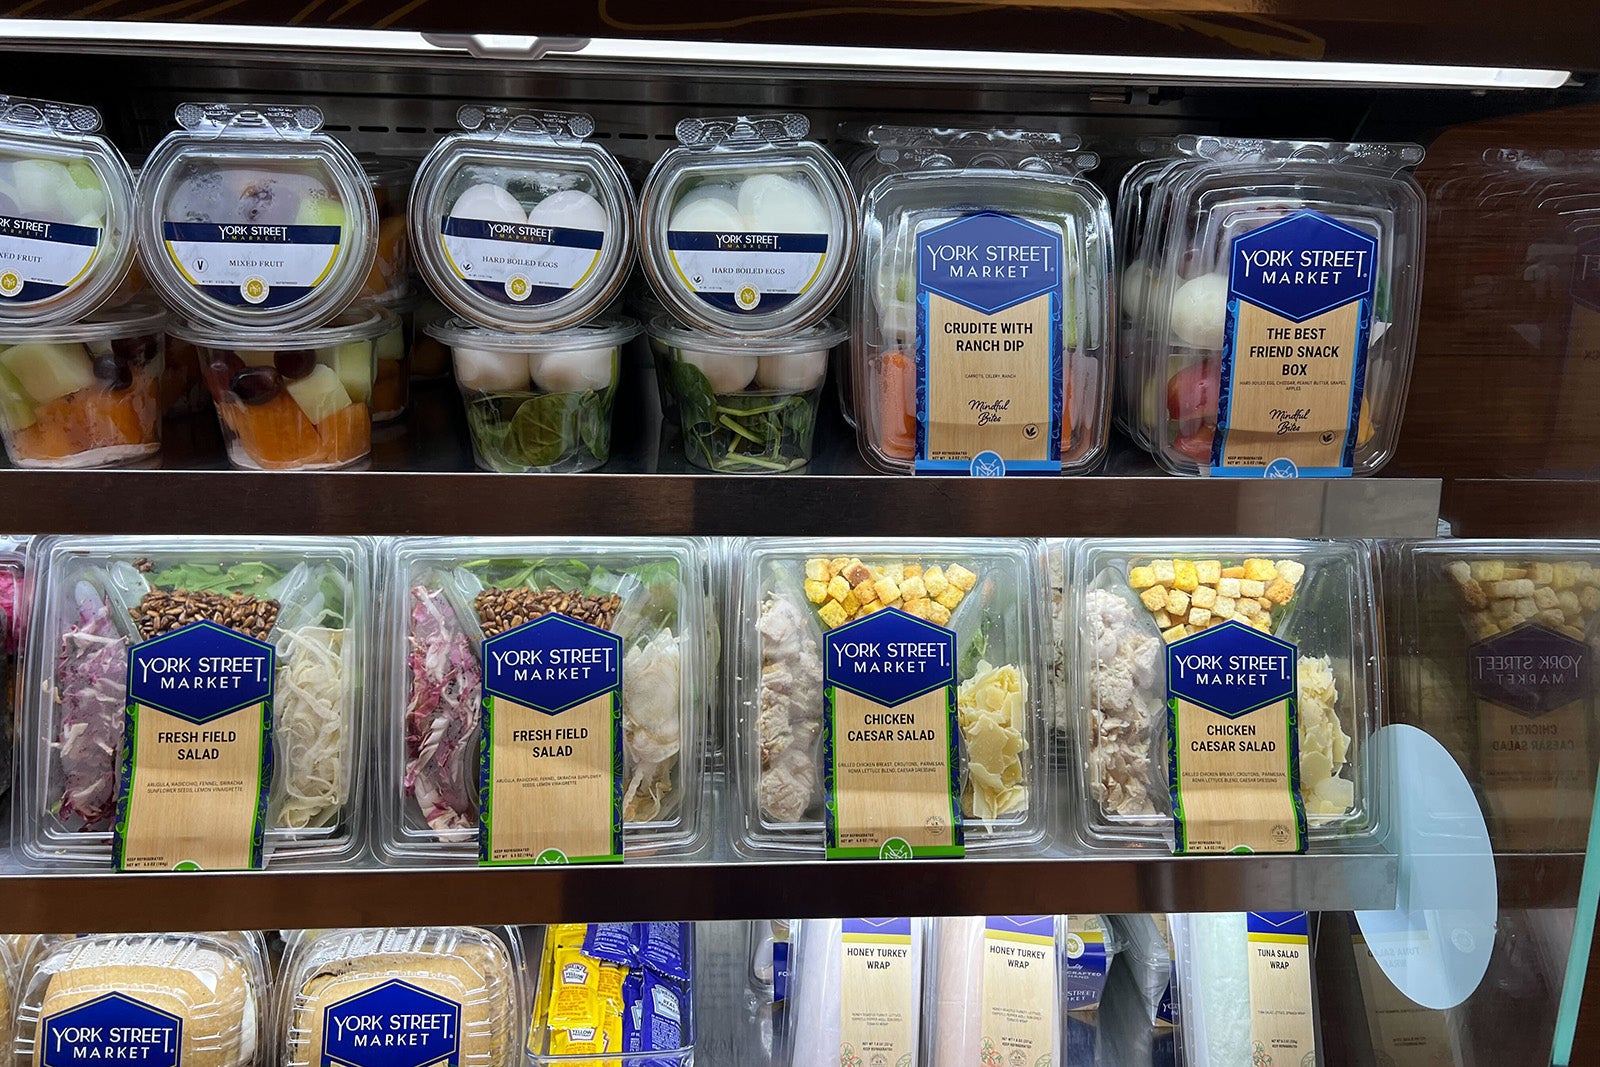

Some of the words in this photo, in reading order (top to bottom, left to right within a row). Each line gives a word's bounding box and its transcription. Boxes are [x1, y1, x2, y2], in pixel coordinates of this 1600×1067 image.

[14, 220, 50, 238] STREET
[218, 225, 248, 240] YORK
[251, 226, 288, 241] STREET
[488, 223, 516, 237] YORK
[518, 226, 553, 242] STREET
[500, 234, 542, 242] MARKET
[716, 234, 742, 248] YORK
[745, 235, 779, 250] STREET
[17, 253, 42, 262] FRUIT
[506, 258, 536, 266] BOILED
[926, 244, 979, 271] YORK
[986, 246, 1052, 272] STREET
[1241, 250, 1294, 277] YORK
[1300, 250, 1367, 278] STREET
[950, 266, 1029, 278] MARKET
[1262, 272, 1342, 284] MARKET
[944, 322, 997, 334] CRUDITE
[1001, 323, 1033, 334] WITH
[1267, 328, 1291, 340] THE
[1294, 328, 1326, 340] BEST
[956, 340, 999, 351] RANCH
[1004, 340, 1024, 351] DIP
[1250, 346, 1293, 358] FRIEND
[1297, 346, 1340, 358] SNACK
[1282, 364, 1308, 376] BOX
[968, 400, 1010, 412] Mindful
[978, 412, 1001, 426] Bites
[1269, 409, 1310, 421] Mindful
[1277, 421, 1300, 435] Bites
[833, 643, 881, 667] YORK
[888, 643, 947, 666] STREET
[492, 650, 543, 676] YORK
[550, 648, 613, 672] STREET
[854, 661, 927, 673] MARKET
[1175, 655, 1222, 678] YORK
[1229, 656, 1288, 680] STREET
[138, 657, 191, 683] YORK
[199, 657, 265, 682] STREET
[515, 667, 591, 681] MARKET
[161, 676, 241, 689] MARKET
[1197, 674, 1267, 685] MARKET
[864, 714, 915, 725] CHICKEN
[513, 730, 552, 742] FRESH
[555, 728, 588, 740] FIELD
[848, 731, 894, 741] CAESAR
[897, 730, 935, 741] SALAD
[1206, 725, 1256, 736] CHICKEN
[158, 732, 198, 743] FRESH
[202, 731, 236, 743] FIELD
[532, 746, 573, 758] SALAD
[1191, 741, 1236, 751] CAESAR
[1239, 741, 1276, 751] SALAD
[178, 749, 219, 760] SALAD
[847, 948, 875, 957] HONEY
[877, 949, 907, 958] TURKEY
[990, 945, 1015, 956] HONEY
[1017, 949, 1046, 959] TURKEY
[1258, 949, 1275, 957] TUNA
[1277, 949, 1299, 959] SALAD
[867, 961, 891, 969] WRAP
[1008, 959, 1030, 969] WRAP
[1270, 961, 1289, 969] WRAP
[333, 1015, 383, 1041] YORK
[390, 1014, 452, 1039] STREET
[52, 1028, 103, 1052] YORK
[110, 1028, 173, 1053] STREET
[355, 1034, 429, 1047] MARKET
[74, 1047, 150, 1059] MARKET
